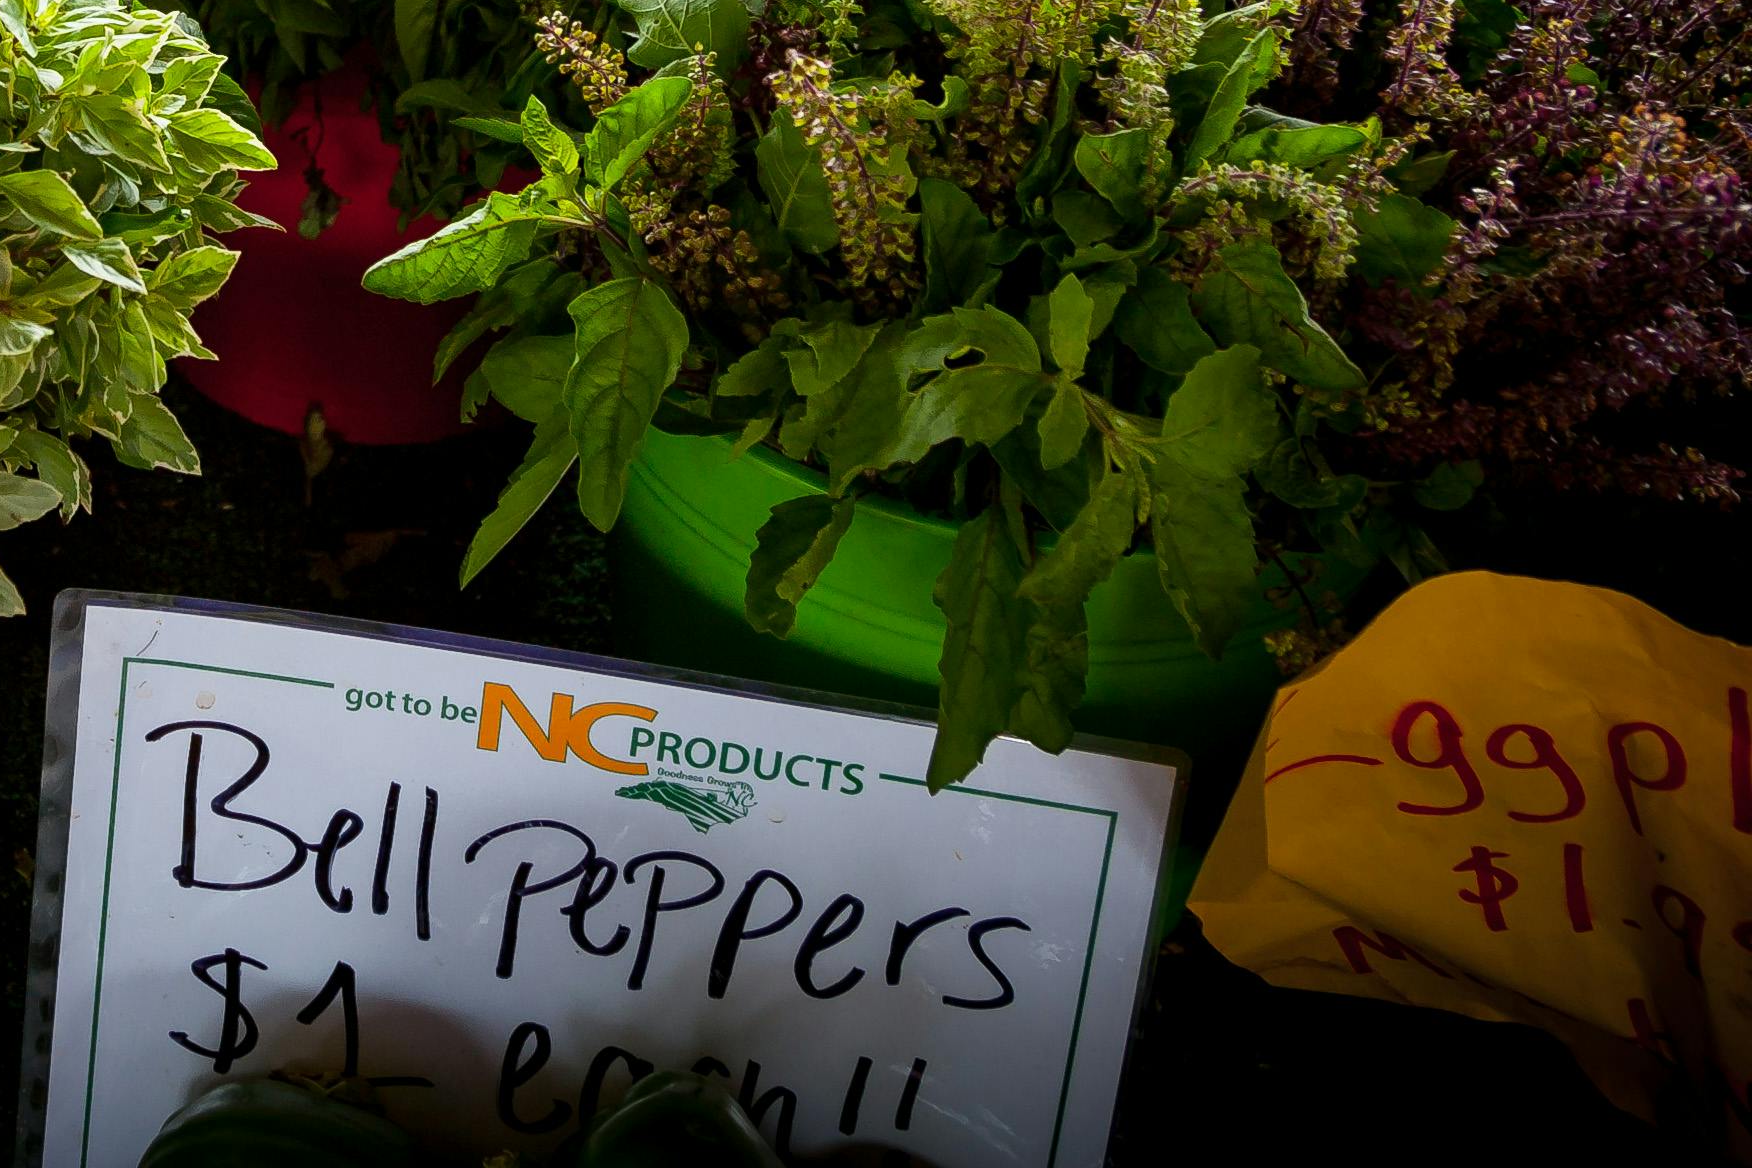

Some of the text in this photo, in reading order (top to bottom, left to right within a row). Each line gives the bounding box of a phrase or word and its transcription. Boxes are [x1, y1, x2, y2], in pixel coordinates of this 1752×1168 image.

[344, 681, 866, 796] got to be NC PRODUCTS
[1265, 685, 1752, 838] ggpl
[144, 719, 440, 941] Bell
